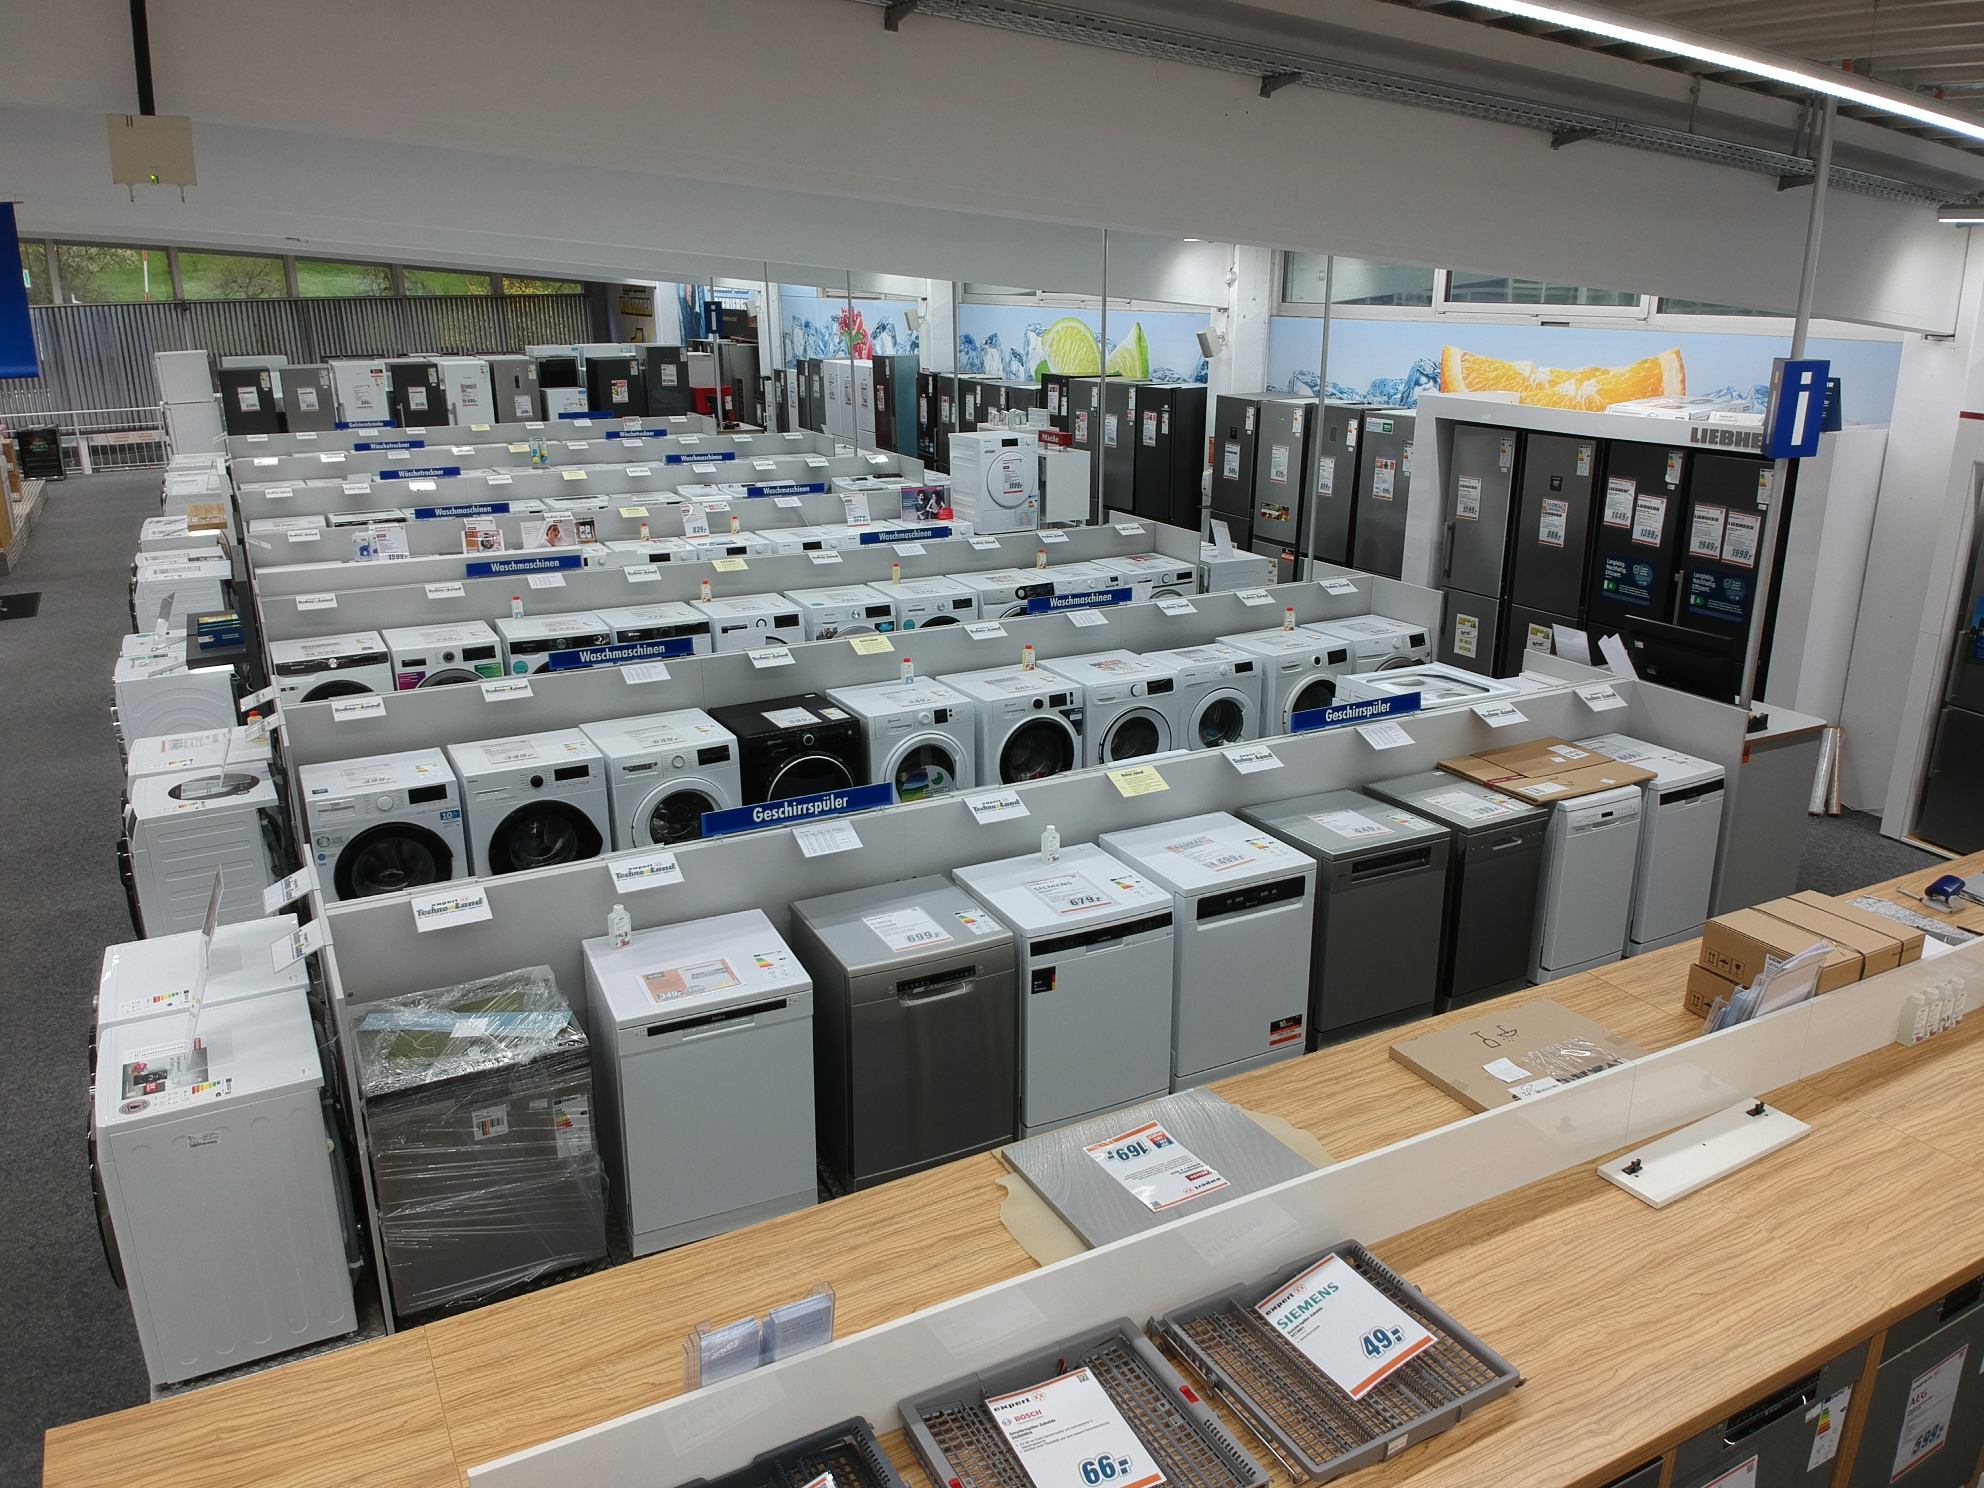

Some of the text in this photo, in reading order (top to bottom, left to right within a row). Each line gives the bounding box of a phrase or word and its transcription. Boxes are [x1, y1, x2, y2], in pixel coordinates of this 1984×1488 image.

[1041, 433, 1060, 443] Miele
[1690, 426, 1763, 449] LIEBHE
[370, 441, 410, 449] Wäschetrockner
[680, 453, 723, 462] Waschmaschinen
[398, 469, 444, 477] Wäschetrockner
[763, 486, 810, 495] Waschmaschinen
[435, 505, 493, 516] Waschmaschinen
[878, 529, 932, 542] Waschmaschinen
[490, 559, 560, 573] Waschmaschinen
[1049, 592, 1112, 608] Waschmaschinen
[579, 644, 666, 663] Waschmaschinen
[1325, 701, 1391, 722] Geschirrspüler
[752, 795, 849, 823] Geschirrspüler
[1034, 881, 1073, 891] SIEMENS
[1193, 1177, 1222, 1190] expert
[1265, 1293, 1295, 1316] expert
[1276, 1281, 1341, 1330] SIEMENS
[993, 1397, 1031, 1412] expert
[1910, 1391, 1928, 1406] AEG
[1014, 1409, 1043, 1423] BOSCH
